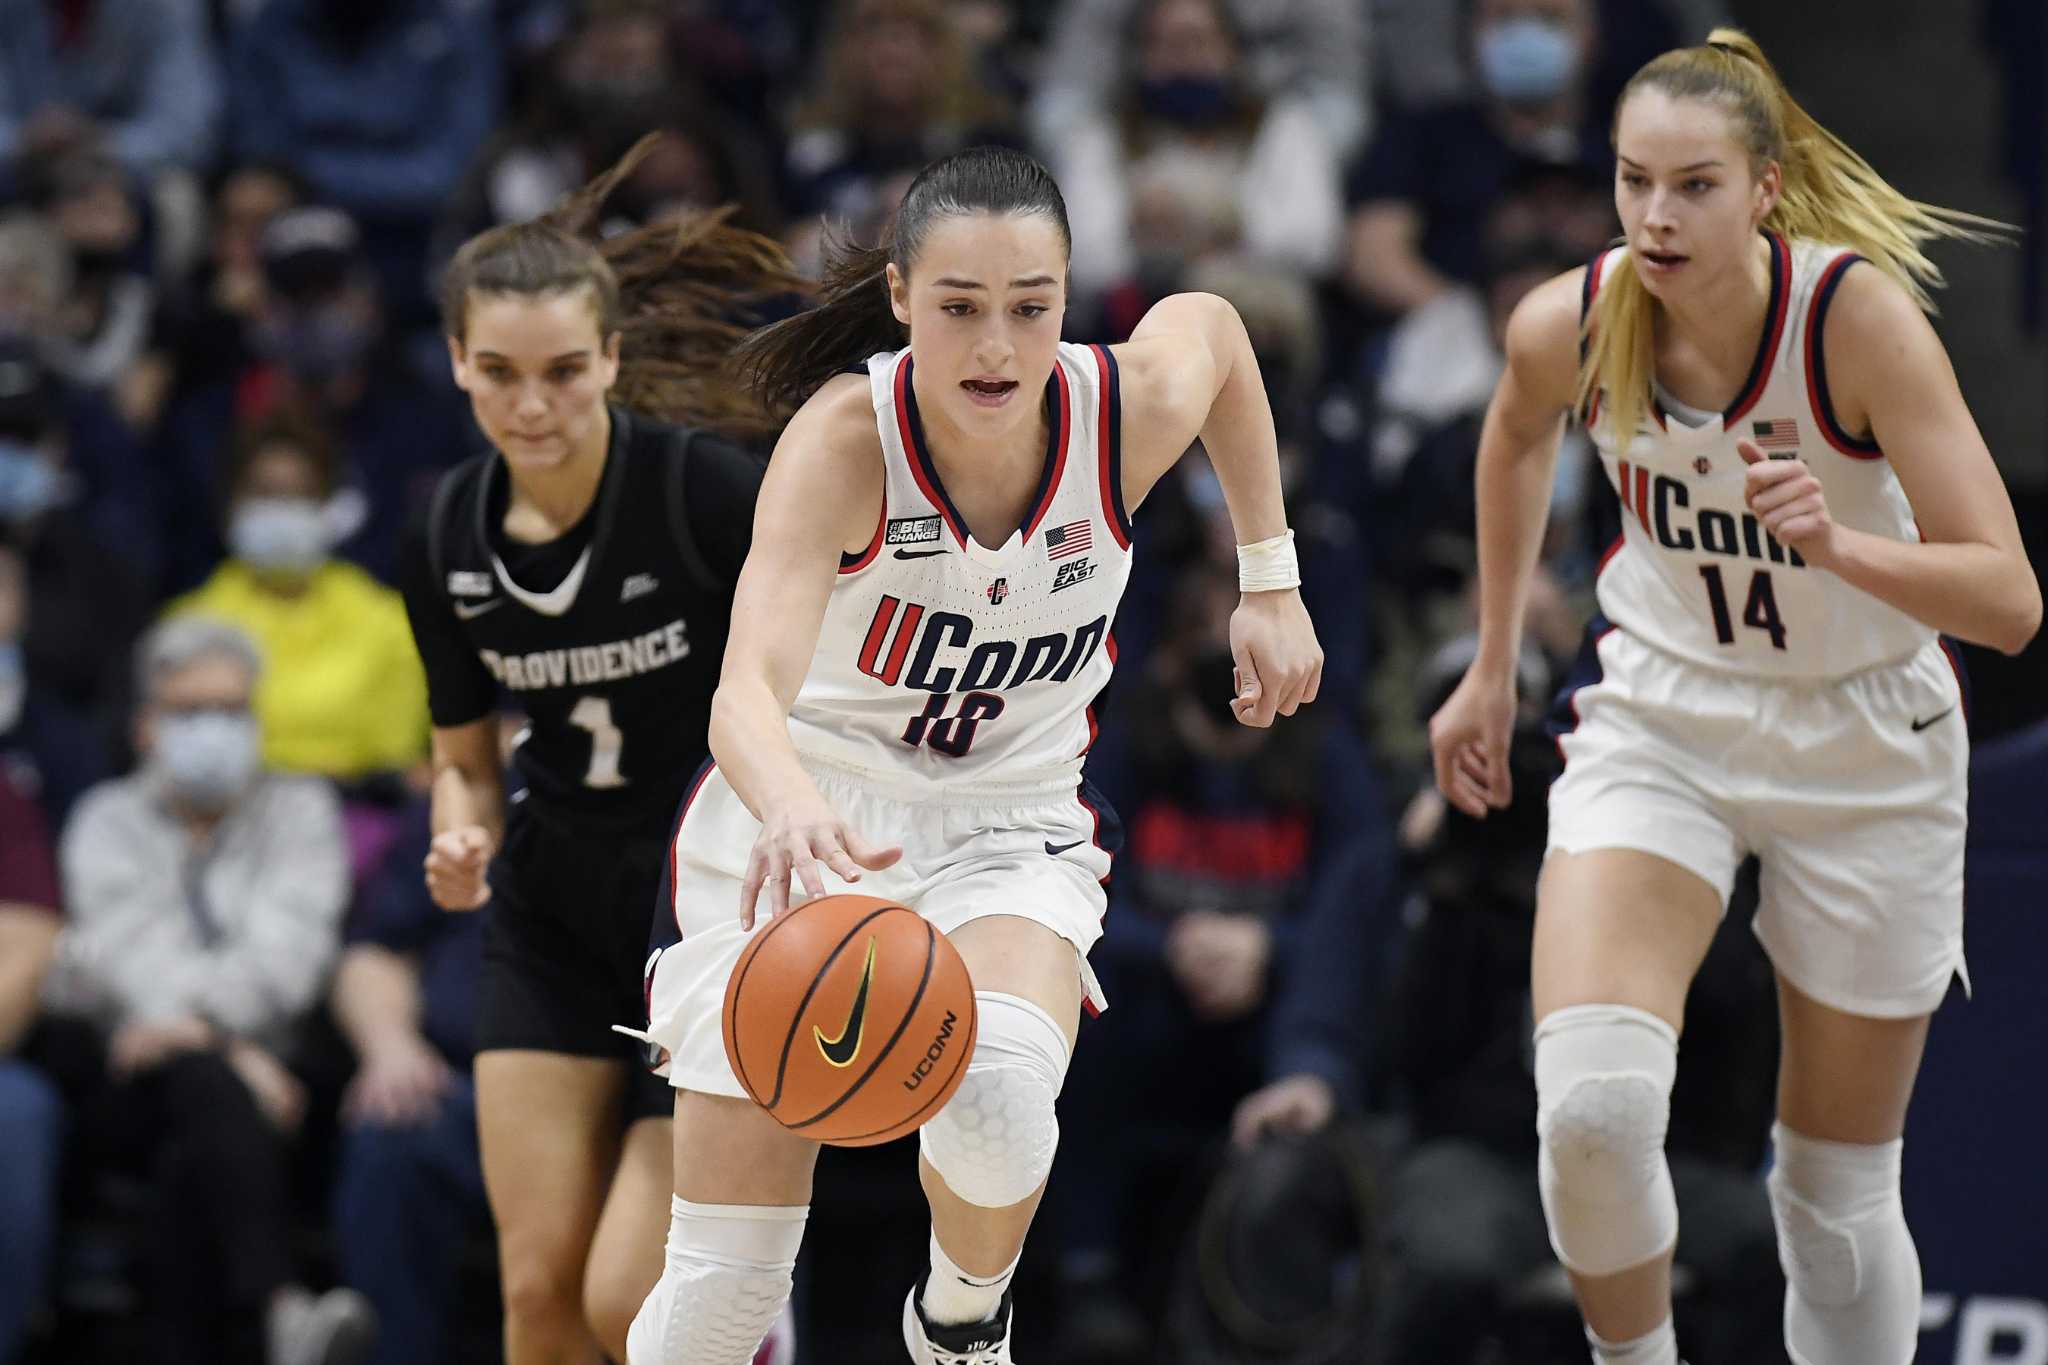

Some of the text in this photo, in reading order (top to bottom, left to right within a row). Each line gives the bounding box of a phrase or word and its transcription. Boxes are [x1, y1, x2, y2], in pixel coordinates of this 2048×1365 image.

[888, 530, 939, 543] CHANGE
[1618, 459, 1806, 568] UCon
[1053, 564, 1098, 588] EAST
[1057, 557, 1089, 577] BIG
[1699, 563, 1788, 650] 14
[568, 696, 627, 788] 1
[903, 1010, 957, 1091] UCONN
